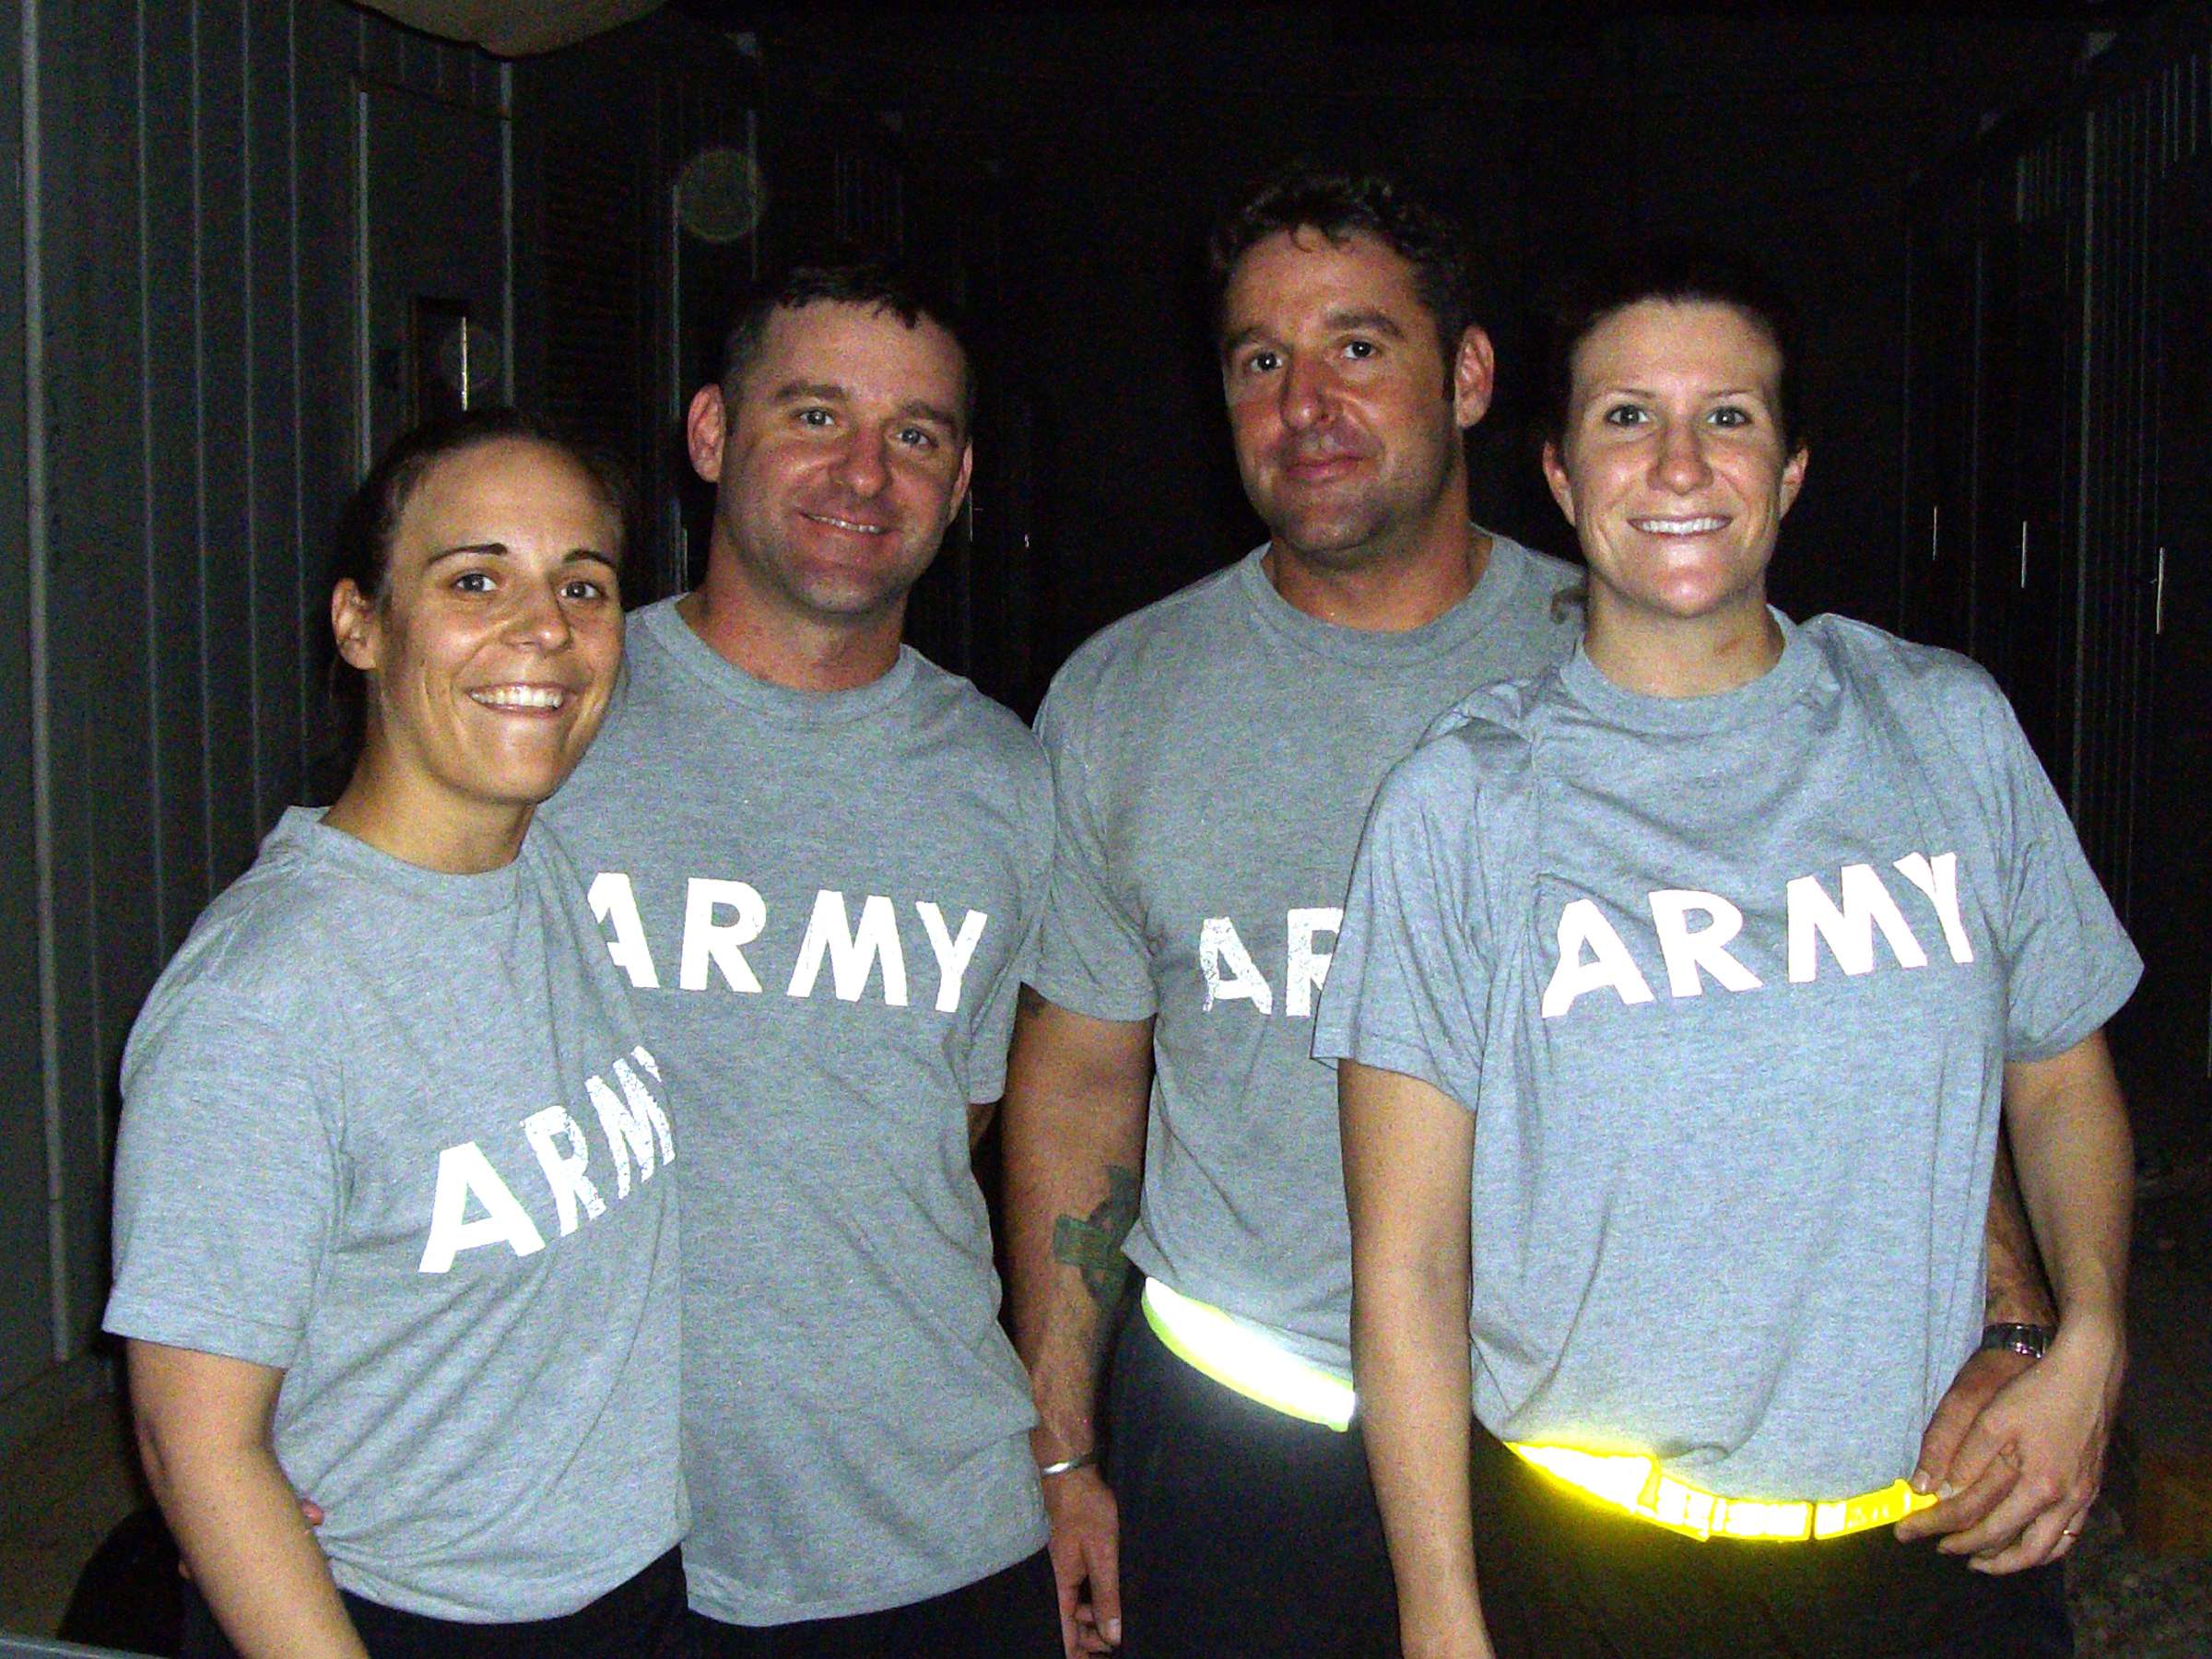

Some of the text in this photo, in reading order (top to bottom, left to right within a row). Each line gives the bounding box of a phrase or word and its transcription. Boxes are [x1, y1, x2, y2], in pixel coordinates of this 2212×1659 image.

[587, 872, 988, 1013] ARMY
[1199, 907, 1344, 1017] AR
[1541, 852, 1973, 1018] ARMY
